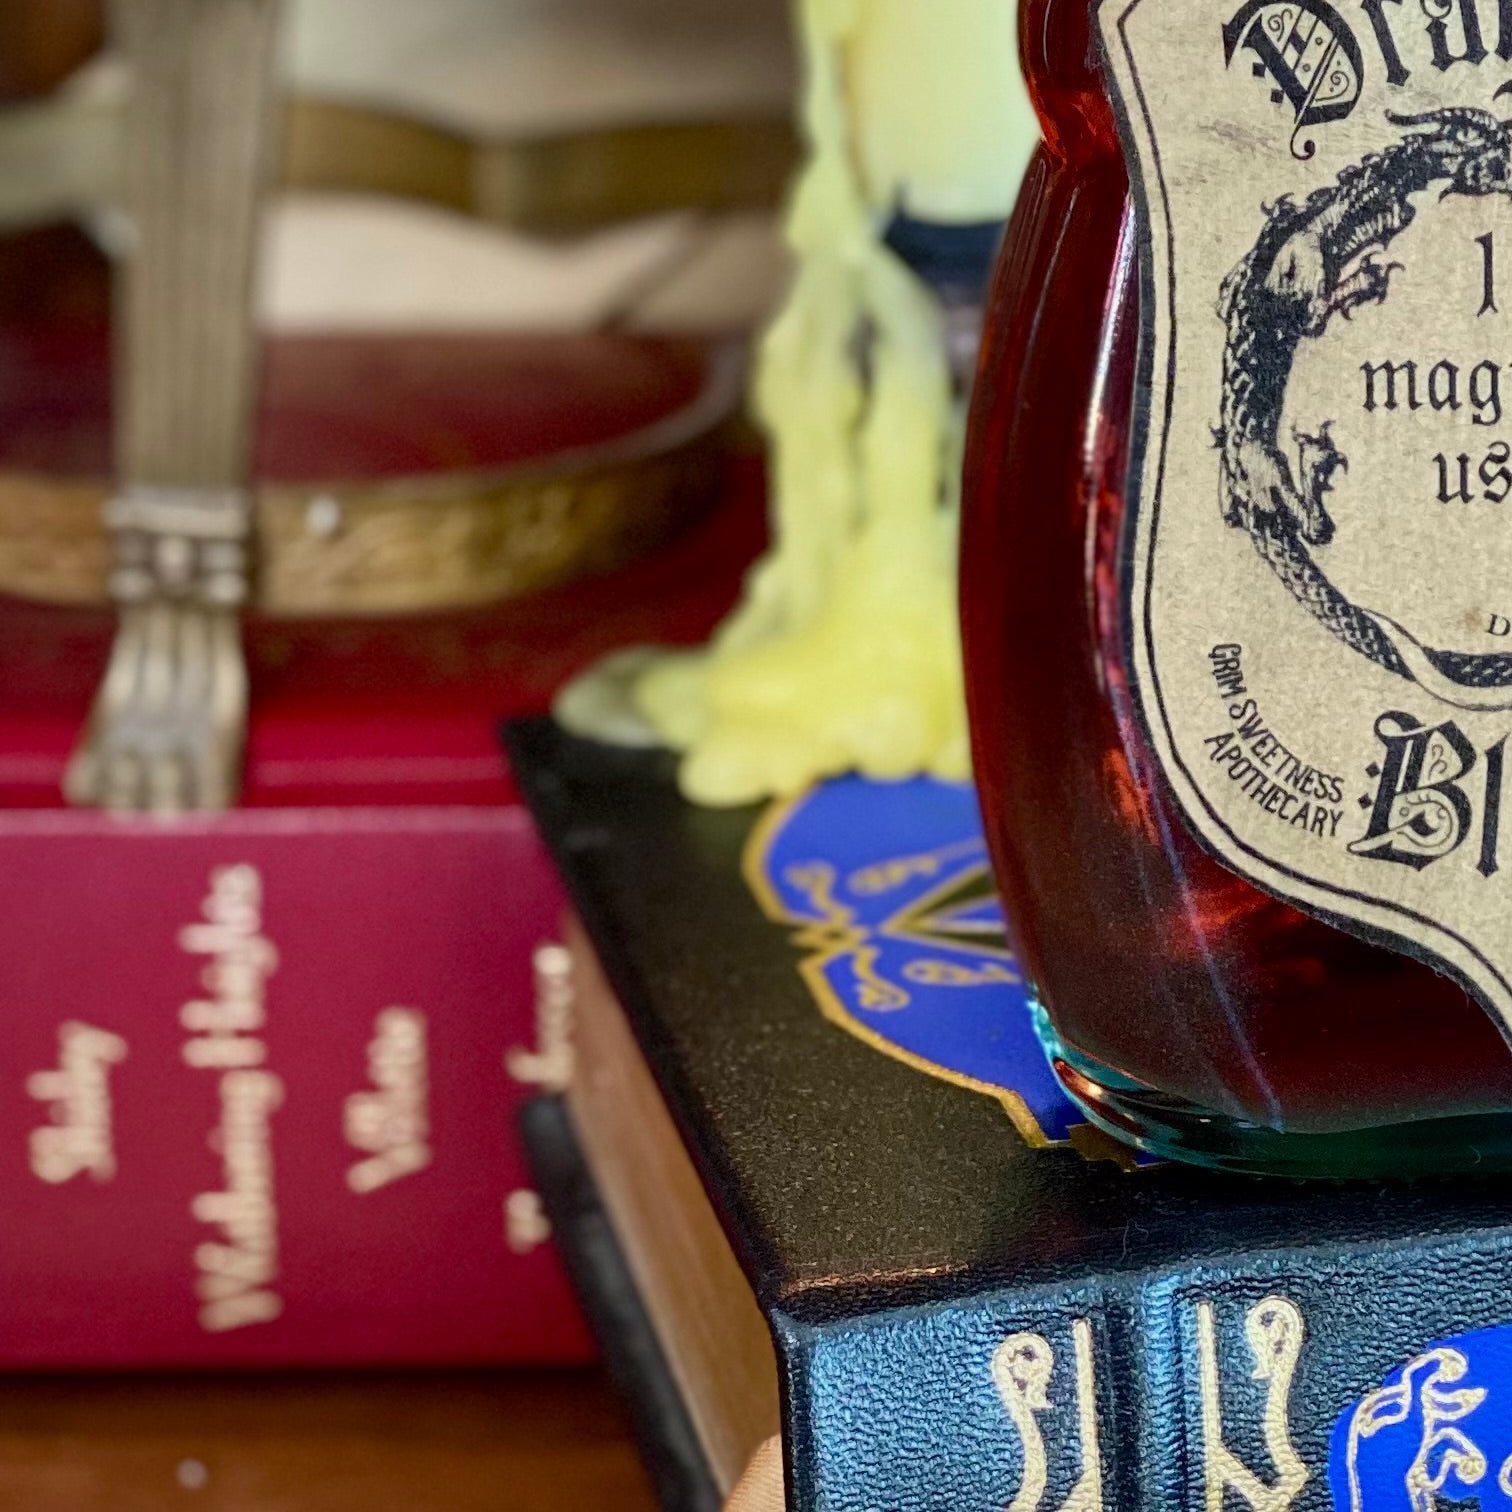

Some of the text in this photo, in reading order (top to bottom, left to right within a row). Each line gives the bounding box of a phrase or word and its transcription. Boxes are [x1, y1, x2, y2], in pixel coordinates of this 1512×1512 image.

[1203, 731, 1344, 838] APOTHECARY
[1207, 642, 1345, 804] GRIM SWEETNESS
